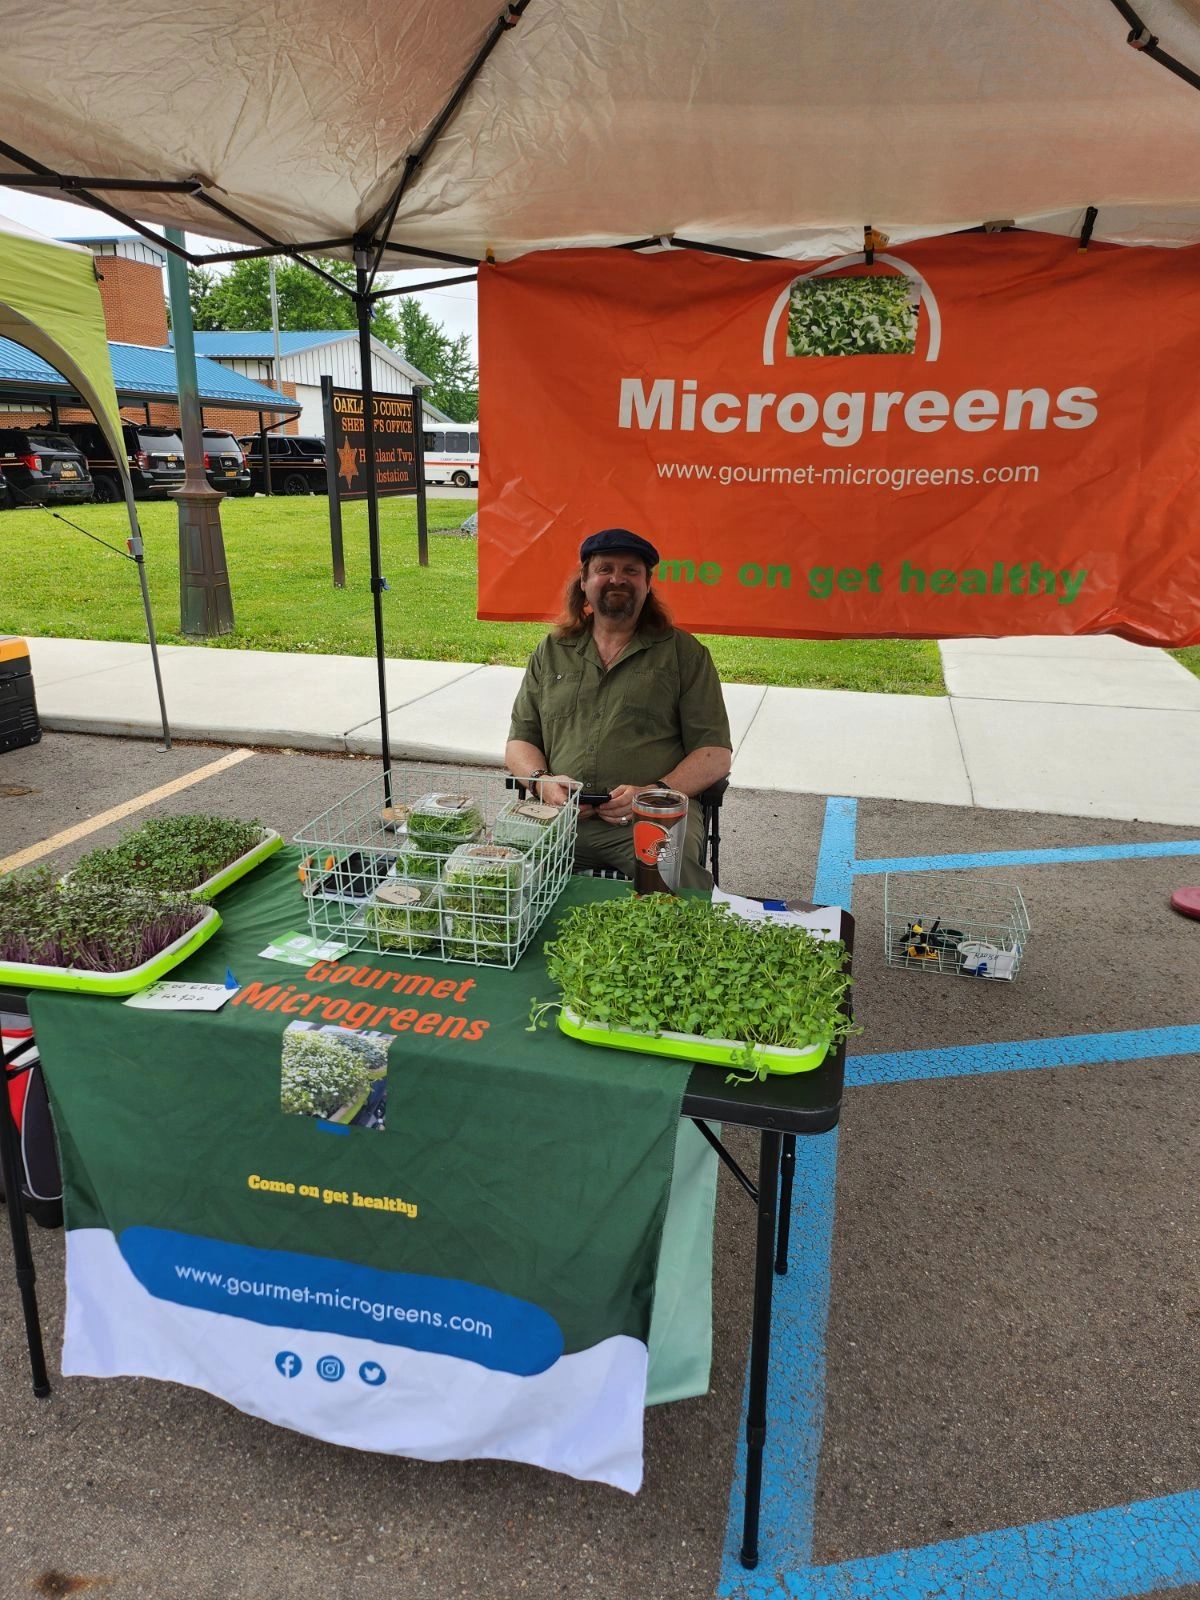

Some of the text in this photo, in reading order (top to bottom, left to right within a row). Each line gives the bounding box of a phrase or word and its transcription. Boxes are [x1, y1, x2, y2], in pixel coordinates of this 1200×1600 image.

[333, 397, 411, 417] OAKLAD COUNTY
[342, 417, 412, 433] SHERF'S OFFICE
[618, 378, 1098, 447] Microgreens
[376, 468, 408, 483] bstation
[656, 462, 1039, 491] www.gourmet-microgreens.com
[653, 560, 1087, 605] me on get healthy
[304, 960, 477, 1003] Gourmet
[231, 981, 490, 1041] Microgreens
[248, 1174, 419, 1218] Come on get healthy
[174, 1265, 493, 1339] www.gourmet-microgreens.com
